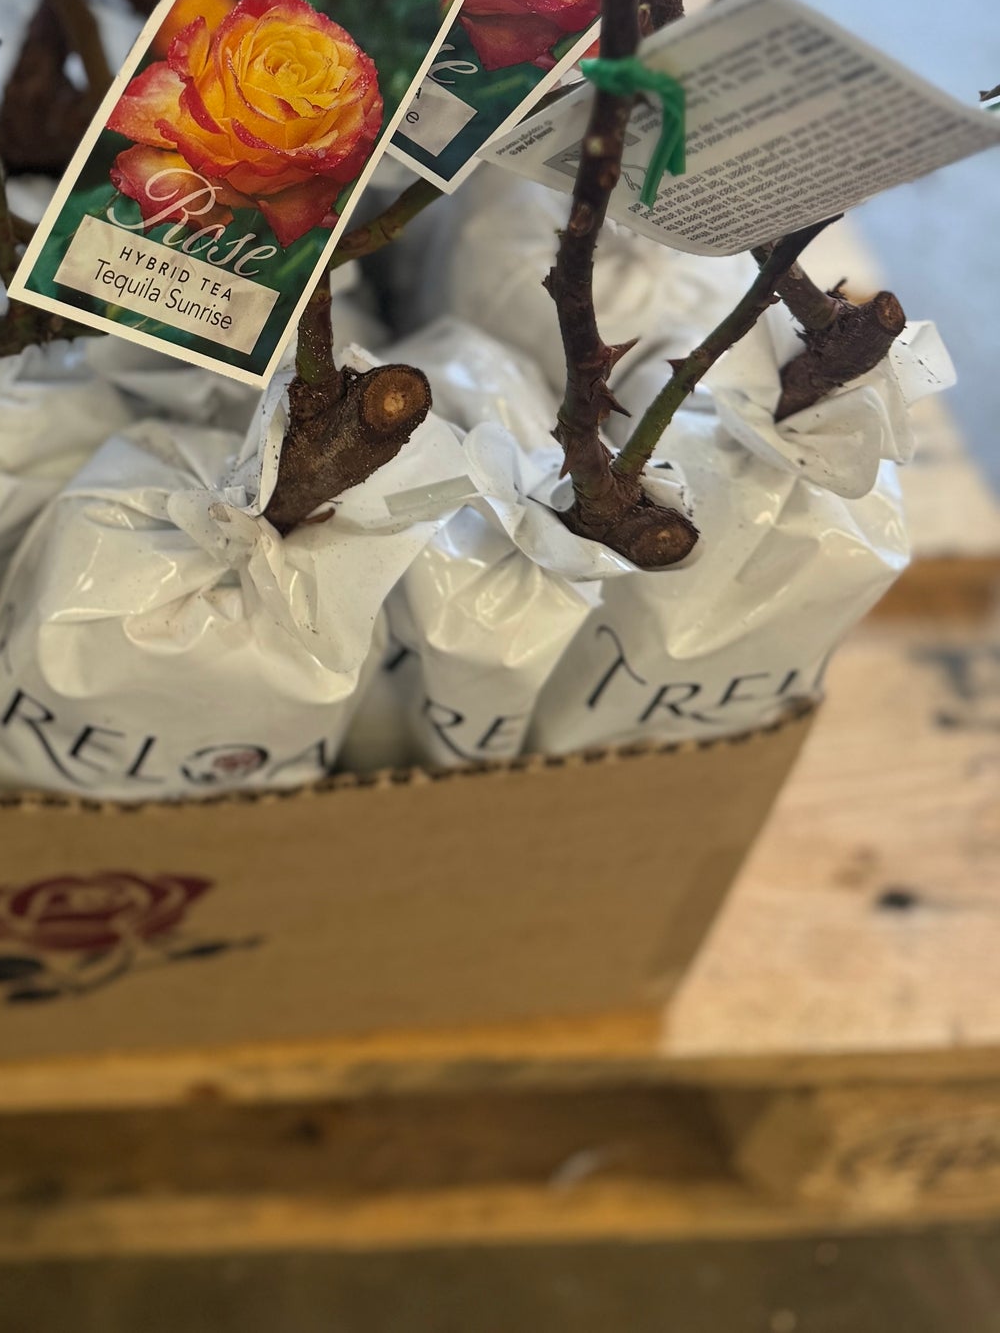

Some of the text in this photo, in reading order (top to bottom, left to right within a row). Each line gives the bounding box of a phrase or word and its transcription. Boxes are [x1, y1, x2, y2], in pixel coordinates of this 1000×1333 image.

[106, 167, 278, 277] Rose
[93, 258, 234, 331] Tequila Sunrise
[118, 245, 233, 302] HYBRID TEA
